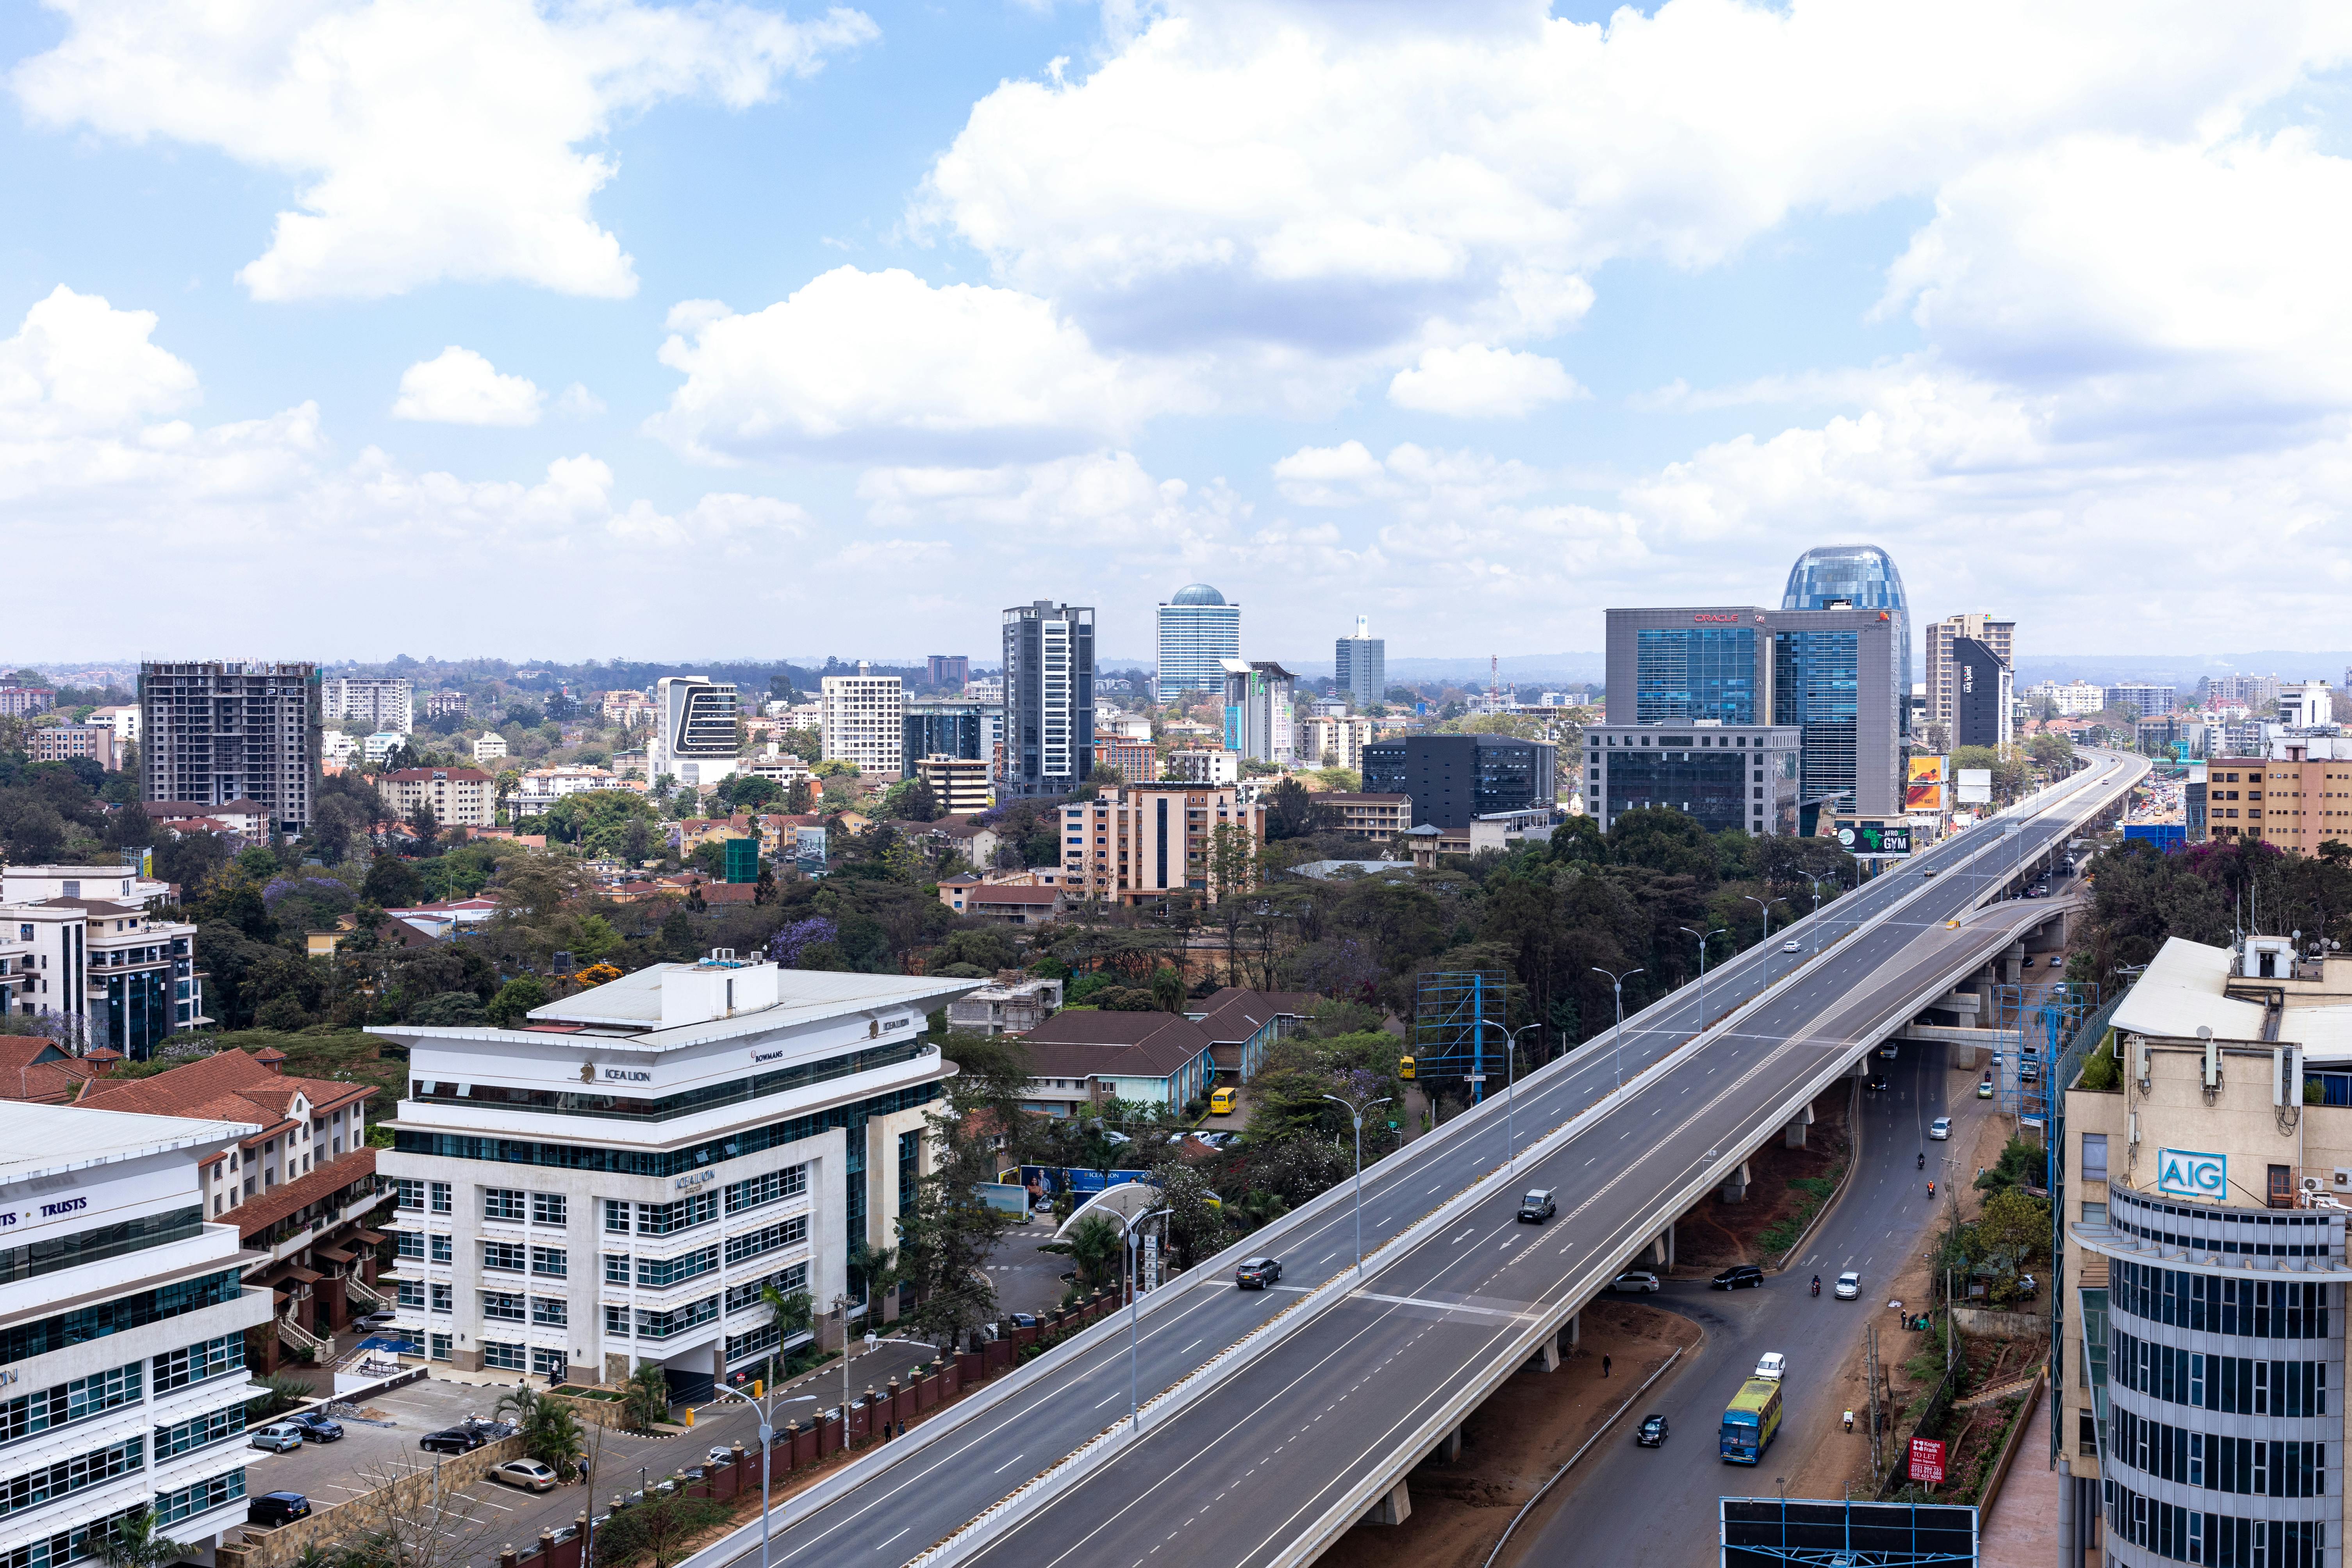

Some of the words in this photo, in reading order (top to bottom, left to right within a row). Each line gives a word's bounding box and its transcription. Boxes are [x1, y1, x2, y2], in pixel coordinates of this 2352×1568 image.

[1964, 666, 1973, 681] park
[1884, 838, 1906, 849] GYM
[755, 1050, 783, 1063] BOWMANS
[605, 1069, 627, 1080] ICEA
[628, 1072, 651, 1081] LION
[675, 1175, 695, 1189] ICEA
[695, 1168, 715, 1184] LION
[2163, 1159, 2221, 1189] AIG
[40, 1197, 87, 1217] TRUSTS
